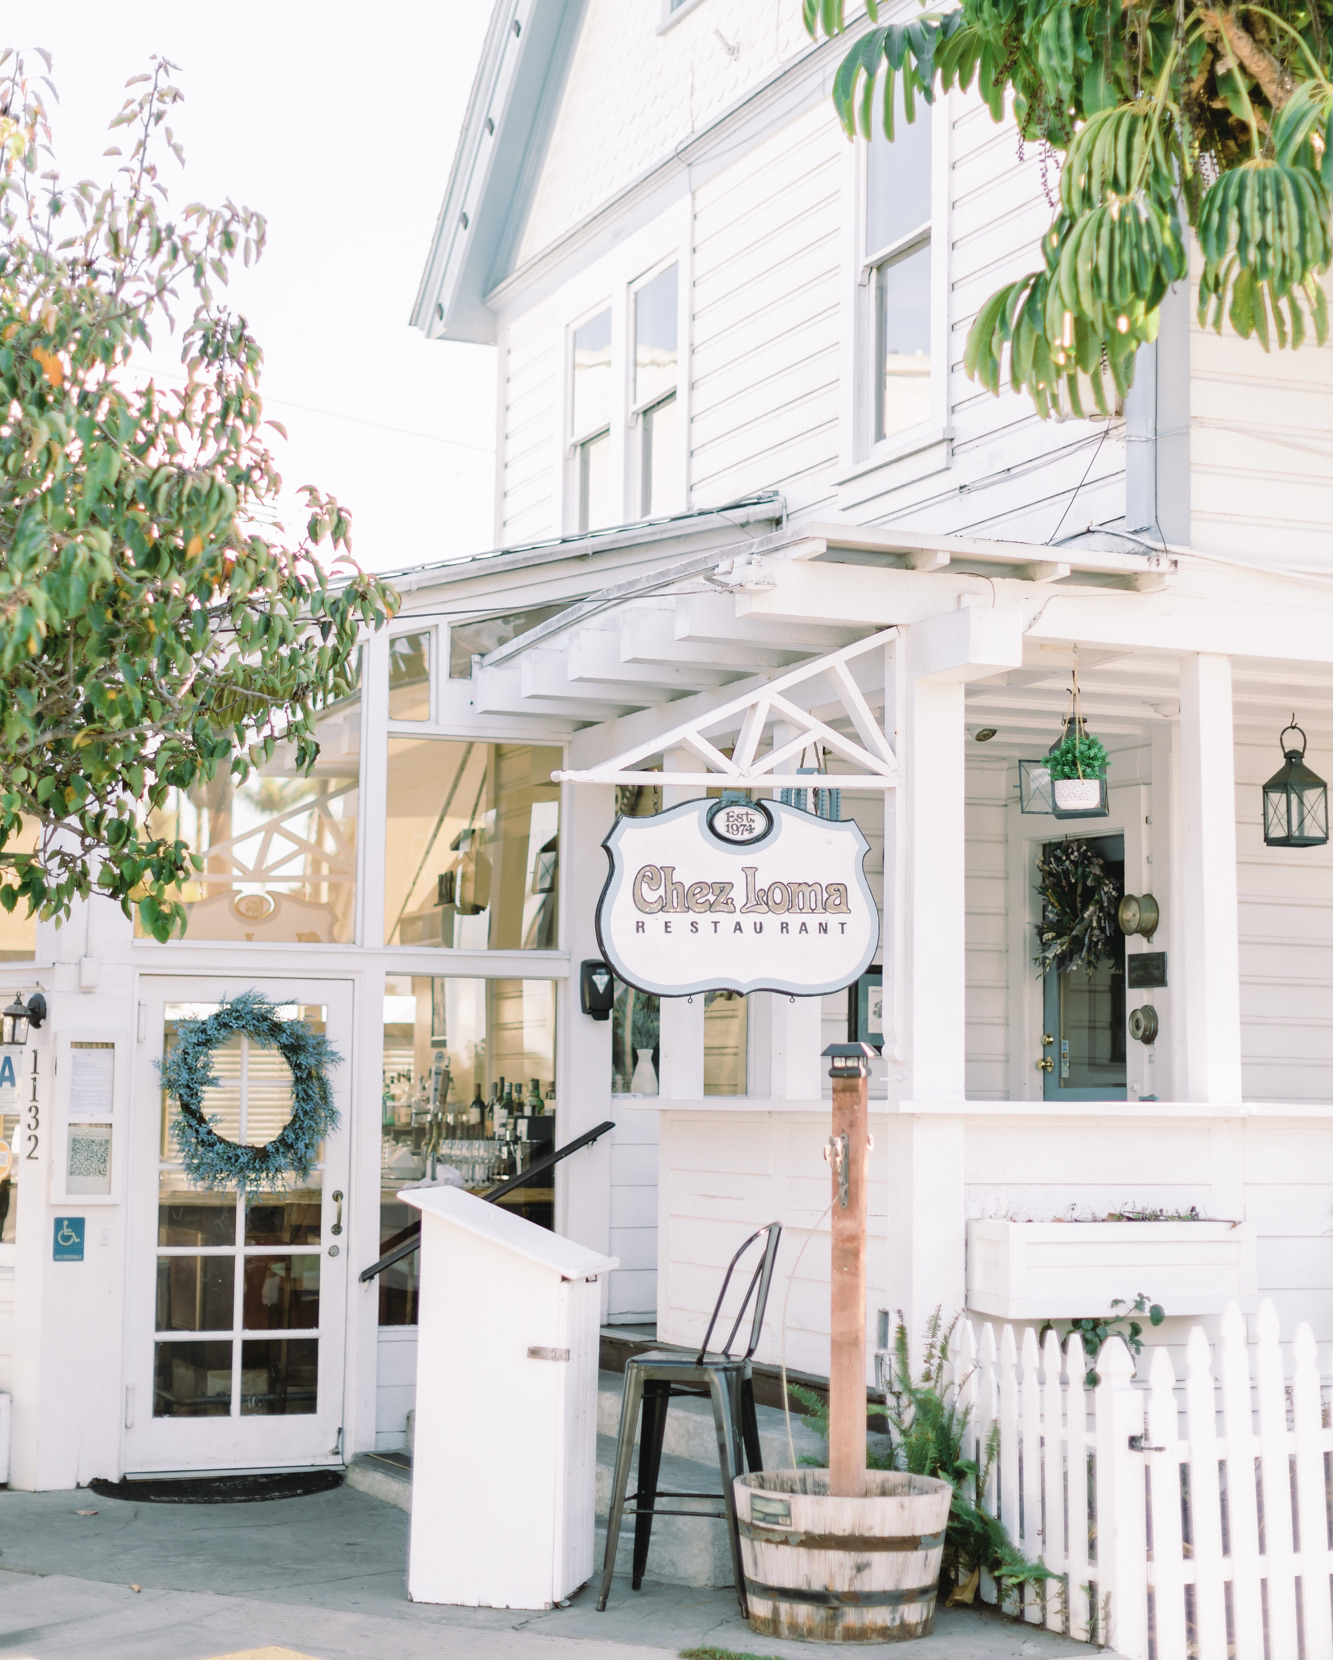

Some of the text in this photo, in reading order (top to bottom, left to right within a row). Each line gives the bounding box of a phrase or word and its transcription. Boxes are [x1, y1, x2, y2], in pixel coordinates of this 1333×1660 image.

[725, 823, 756, 836] 1974
[633, 864, 851, 915] Chez Loma
[635, 921, 847, 934] RESTAURANT
[0, 1056, 16, 1088] A
[26, 1049, 40, 1160] 1132
